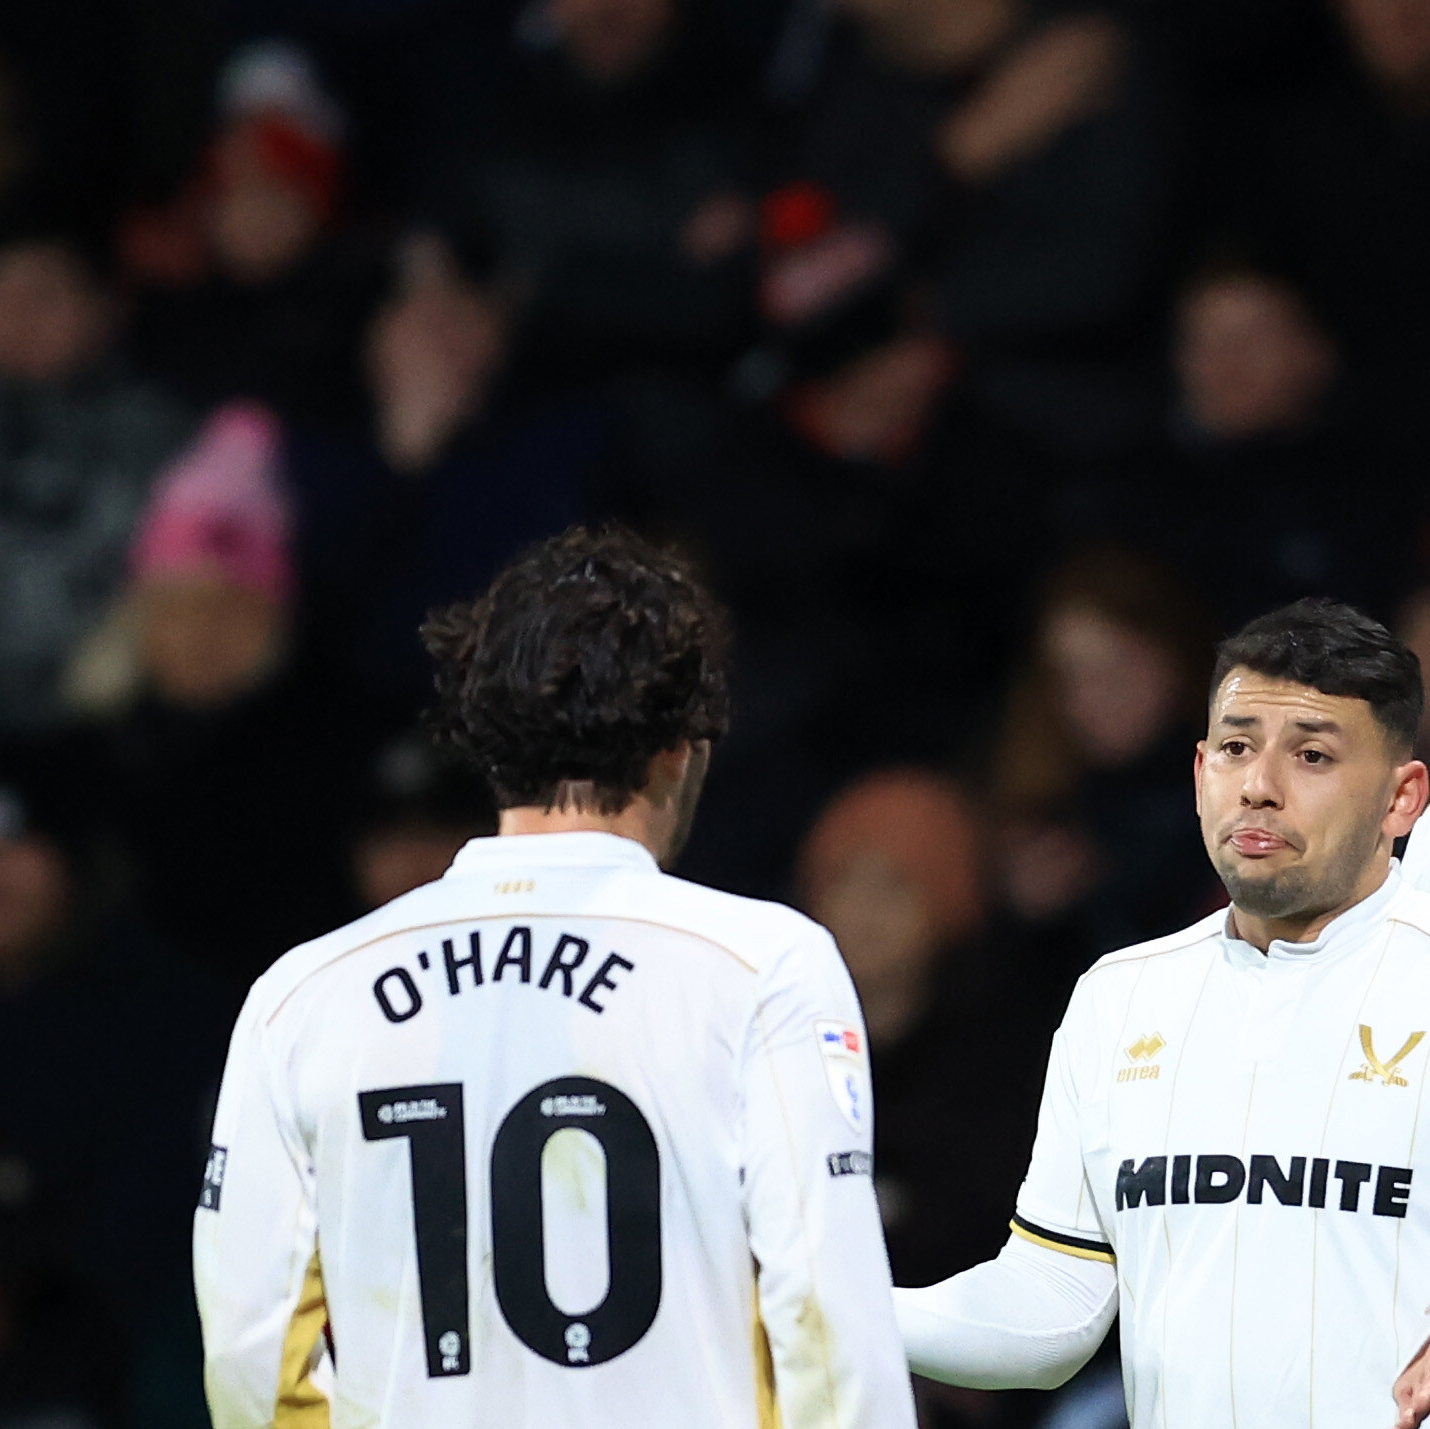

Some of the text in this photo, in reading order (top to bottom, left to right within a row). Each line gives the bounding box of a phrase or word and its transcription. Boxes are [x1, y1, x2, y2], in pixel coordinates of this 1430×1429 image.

[373, 926, 635, 1023] O'HARE
[357, 1075, 662, 1378] 10
[1115, 1154, 1414, 1219] MIDNITE
